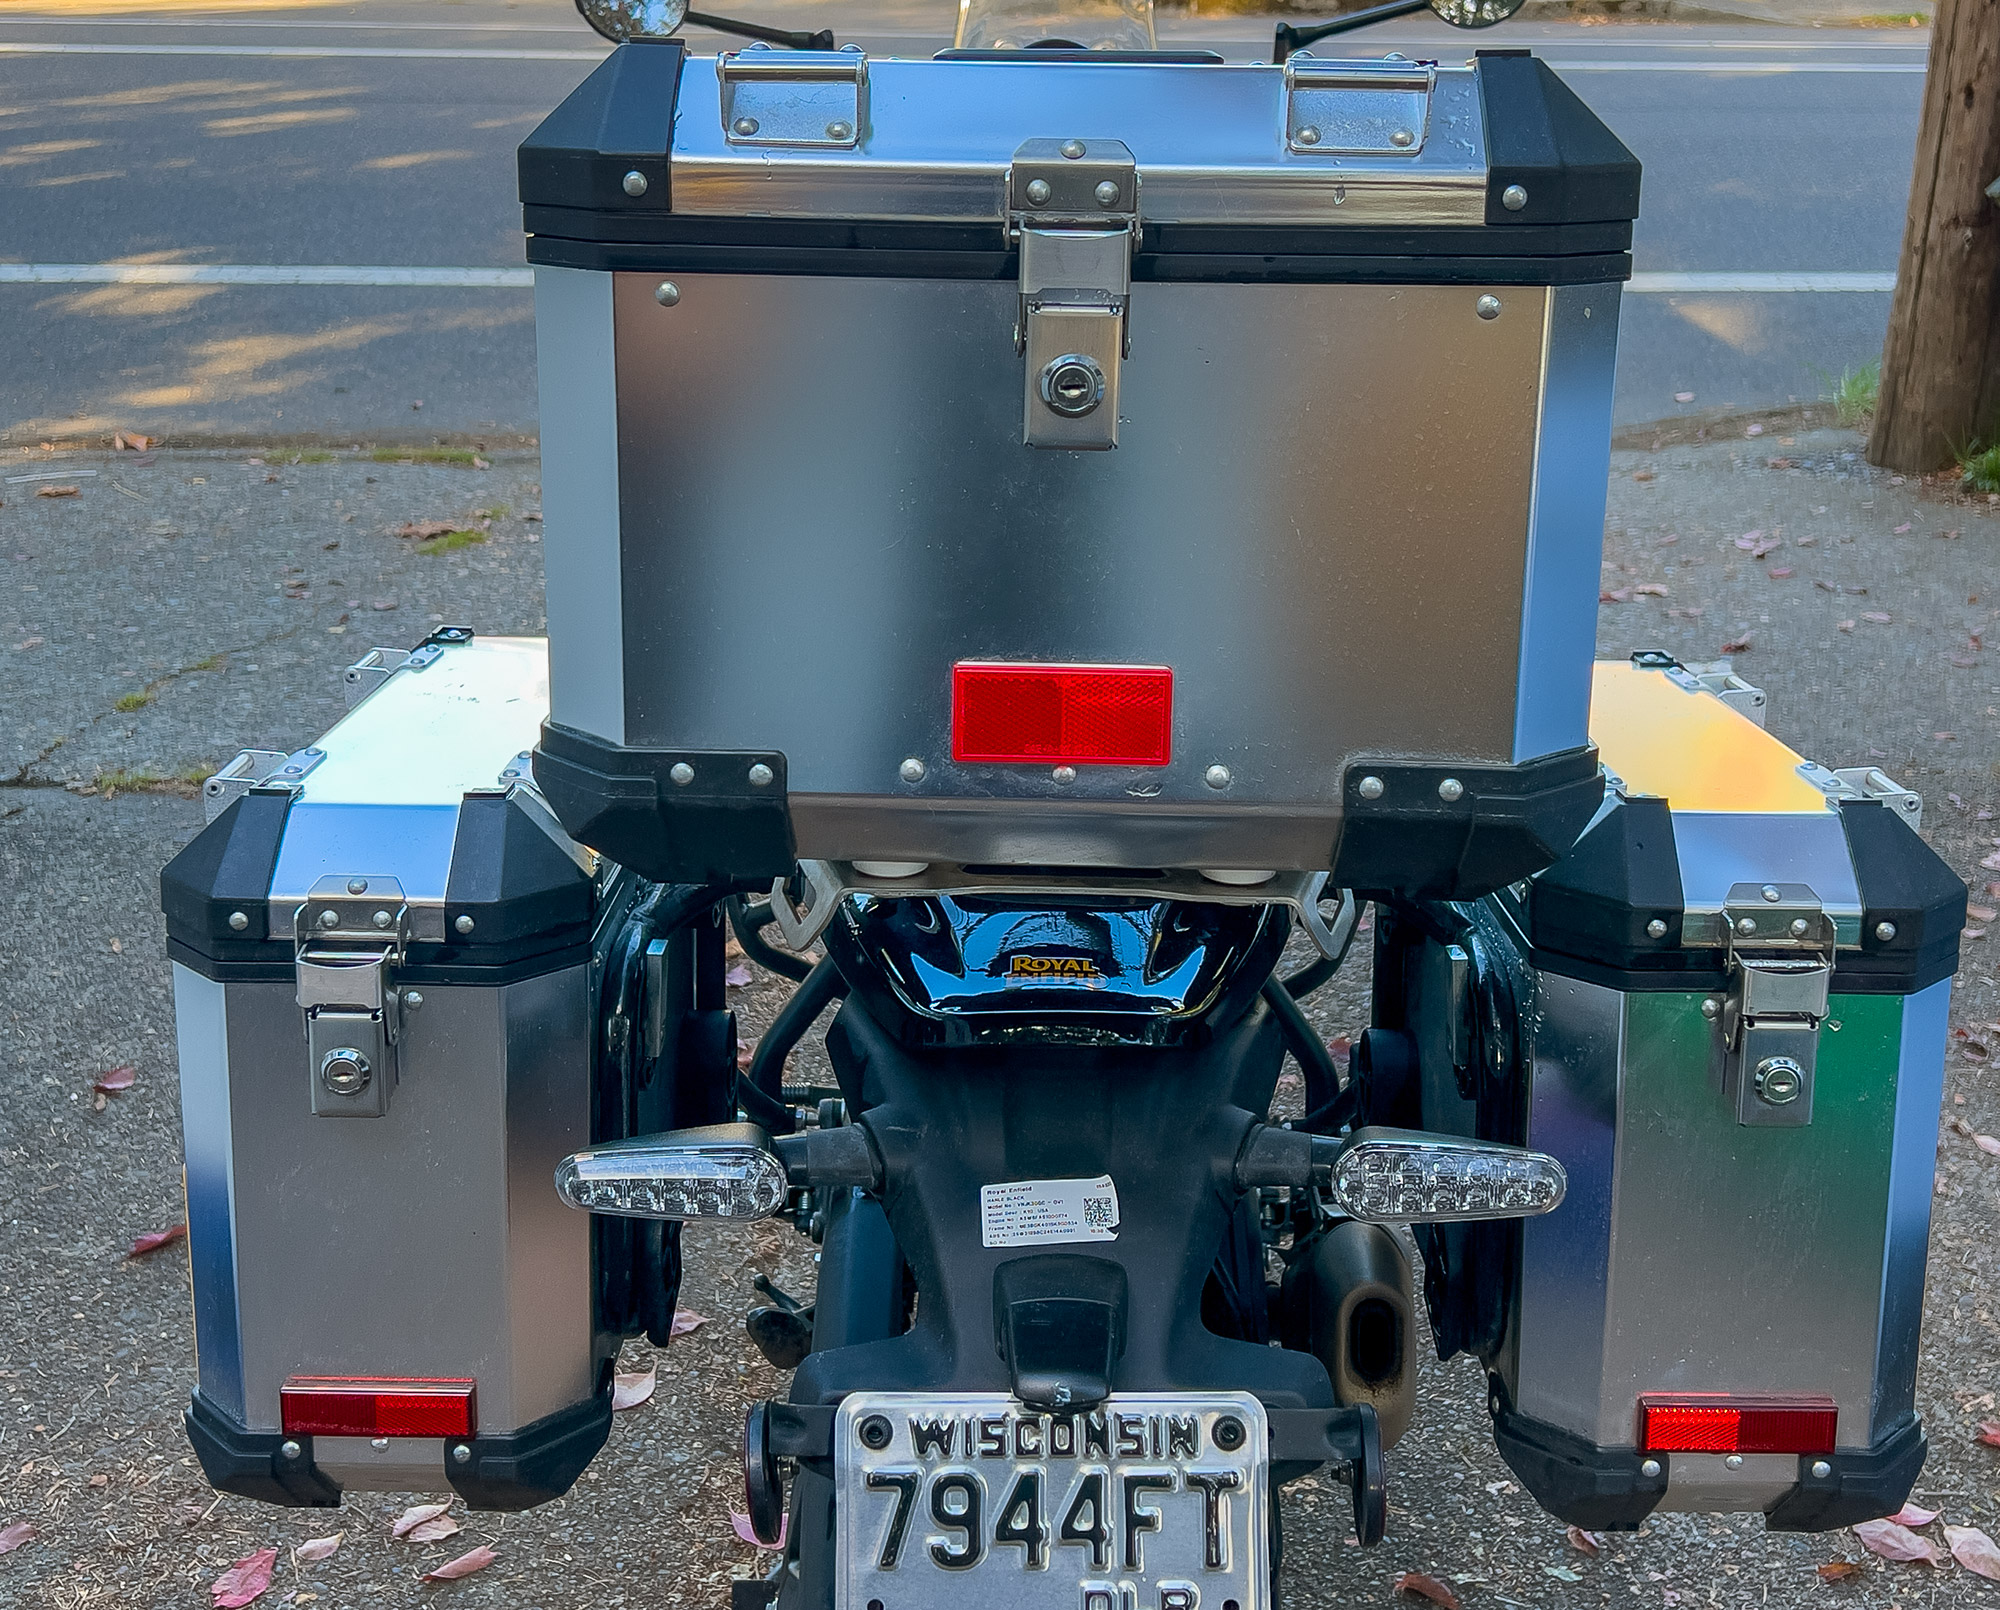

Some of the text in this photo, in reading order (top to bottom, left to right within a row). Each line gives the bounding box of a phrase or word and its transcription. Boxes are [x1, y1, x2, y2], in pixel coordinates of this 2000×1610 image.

[1013, 957, 1096, 972] ROYAL
[908, 1413, 1201, 1457] WISCONSIN
[865, 1468, 1242, 1571] 7944FT
